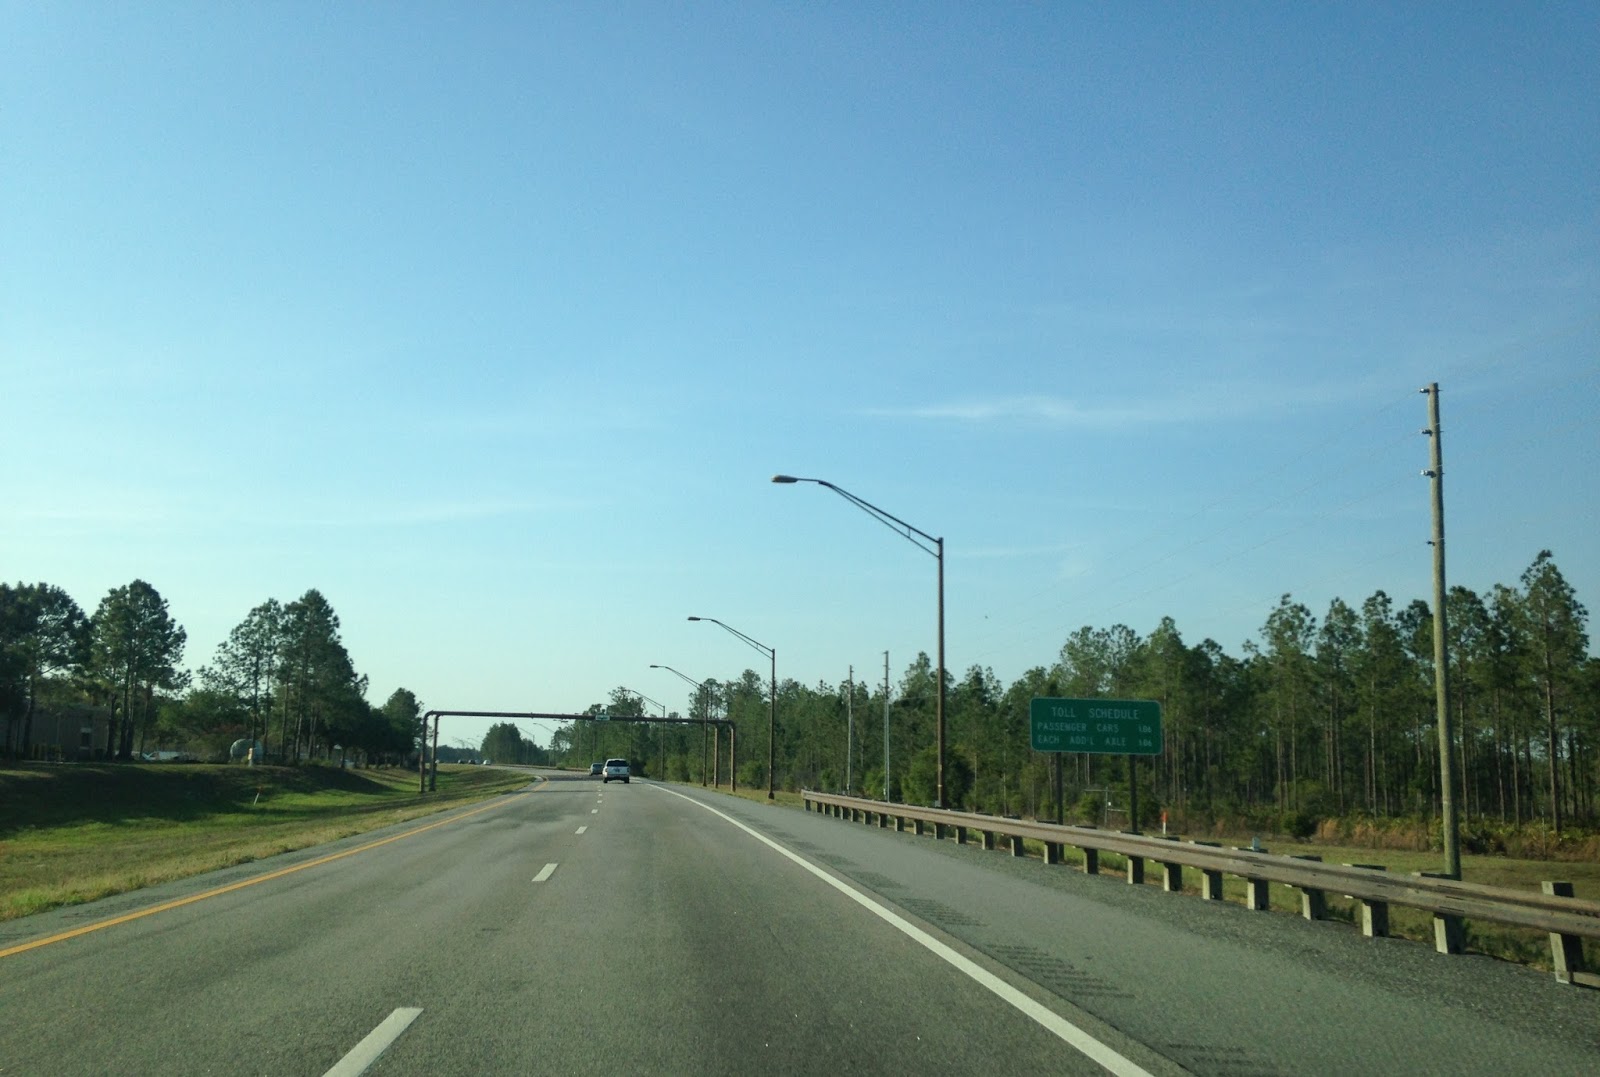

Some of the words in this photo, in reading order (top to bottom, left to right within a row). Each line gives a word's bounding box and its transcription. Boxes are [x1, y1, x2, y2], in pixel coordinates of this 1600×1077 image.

[1050, 706, 1076, 718] TOLL
[1088, 707, 1140, 720] SCHEDULE
[1037, 721, 1087, 732] PASSENGER
[1096, 723, 1119, 733] CARS
[1037, 734, 1060, 744] EACH
[1069, 735, 1095, 746] ADD'L
[1104, 736, 1127, 746] AXLE
